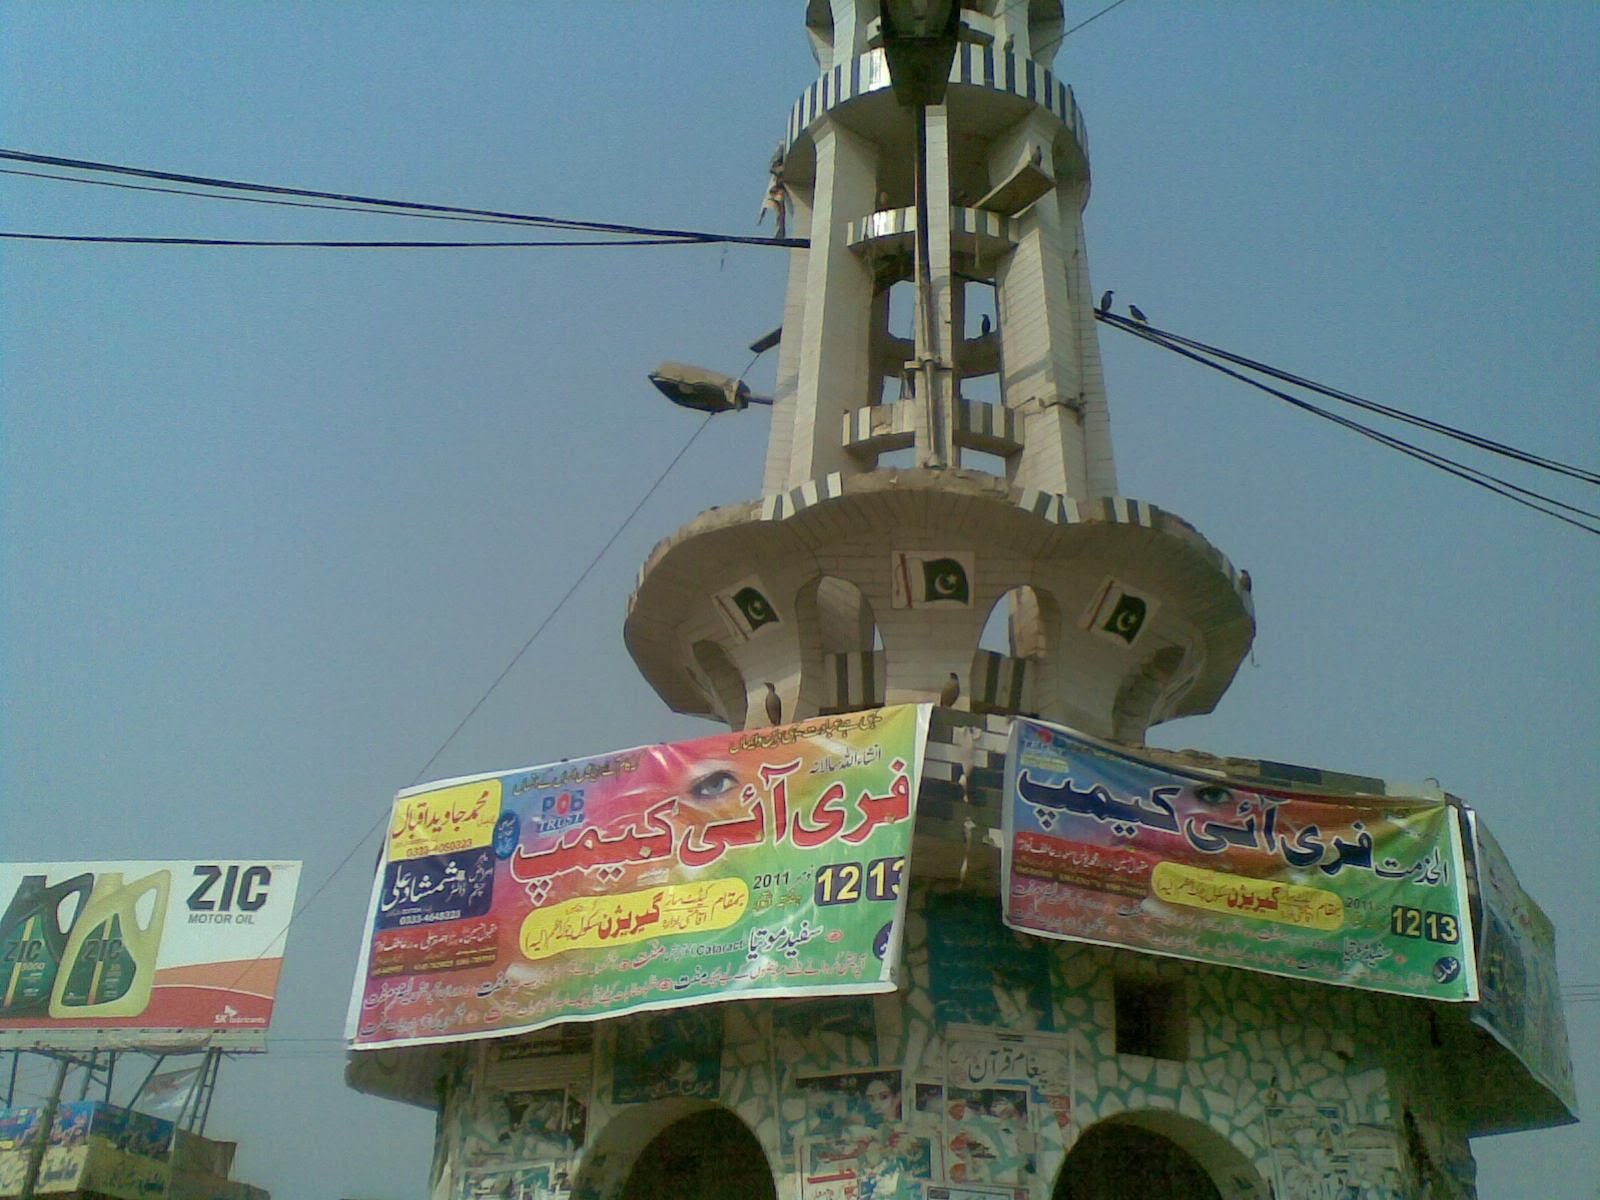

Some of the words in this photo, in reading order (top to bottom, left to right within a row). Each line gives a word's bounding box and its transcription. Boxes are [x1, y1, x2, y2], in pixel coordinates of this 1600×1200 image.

[392, 802, 431, 839] اقبال
[464, 790, 491, 823] محمد
[677, 757, 803, 868] آئی
[791, 758, 912, 848] فری
[1017, 768, 1183, 839] کیمپ
[1185, 795, 1291, 855] آئی
[510, 795, 681, 906] کیمپ
[1279, 820, 1374, 876] فری
[1375, 846, 1449, 887] الخدمت
[186, 865, 272, 912] ZIC
[753, 871, 790, 891] 2011
[817, 865, 859, 902] 12
[188, 914, 232, 926] MOTOR
[235, 913, 256, 925] OIL
[597, 890, 664, 940] گیریژن
[1393, 907, 1421, 937] 12
[1426, 912, 1458, 943] 13
[697, 940, 744, 956] Cataract
